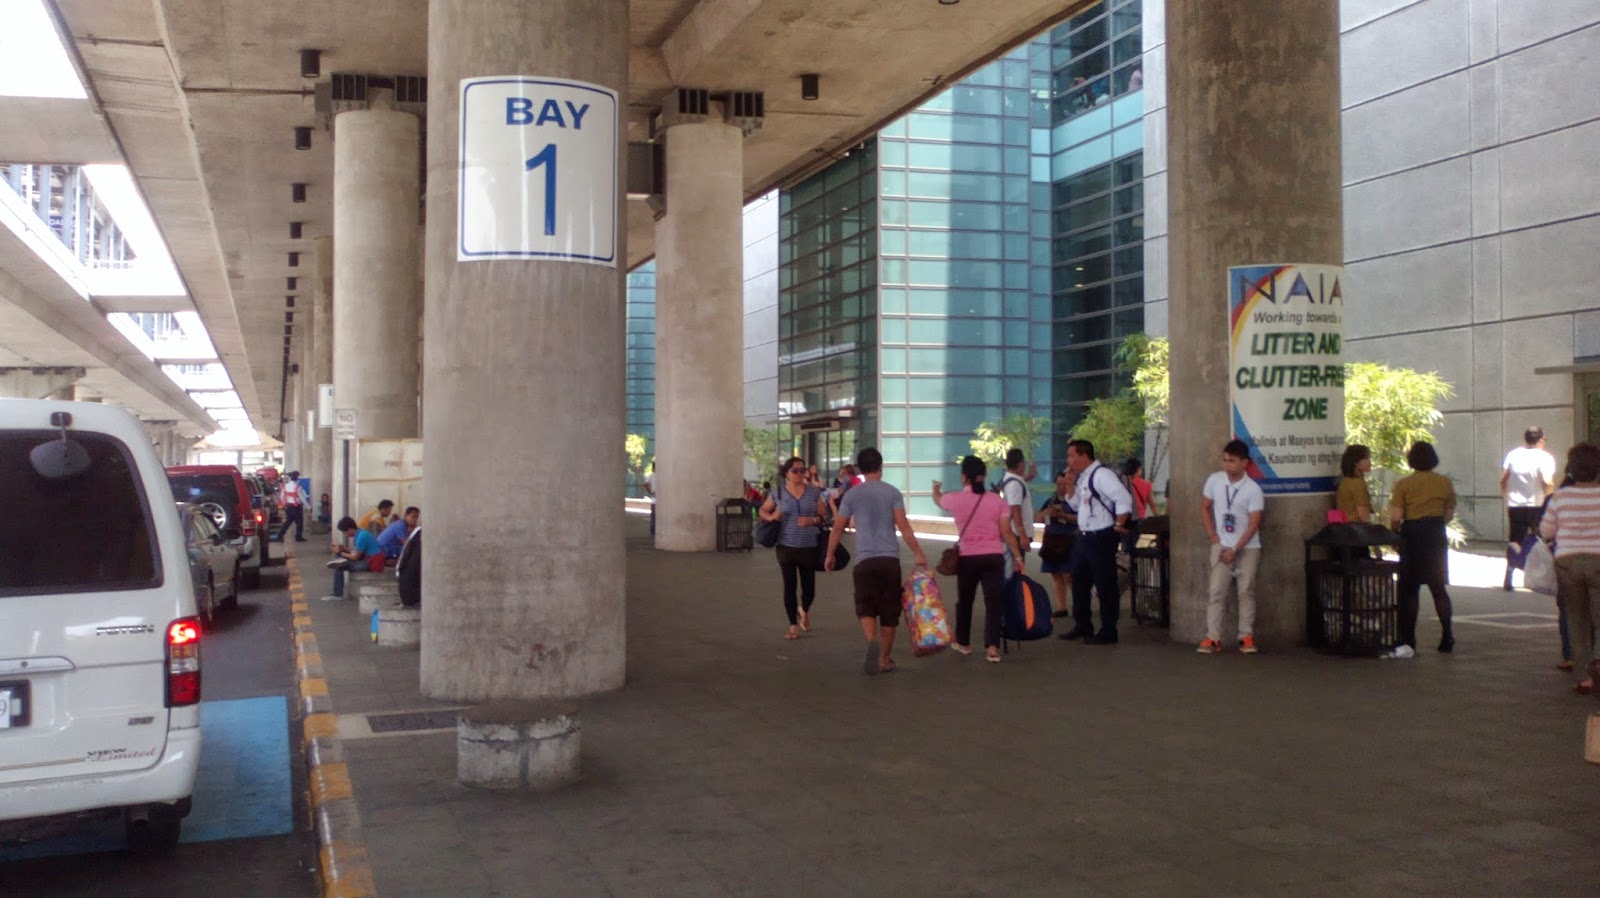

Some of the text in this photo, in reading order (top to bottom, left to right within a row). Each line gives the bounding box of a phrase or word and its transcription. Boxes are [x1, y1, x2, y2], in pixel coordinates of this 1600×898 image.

[506, 97, 590, 130] BAY
[525, 143, 557, 236] 1
[1240, 271, 1343, 305] NAIA
[1253, 312, 1303, 325] Working
[1251, 331, 1315, 356] LITTER
[340, 414, 353, 423] NO
[1282, 397, 1328, 420] ZONE
[96, 624, 154, 636] FOTON
